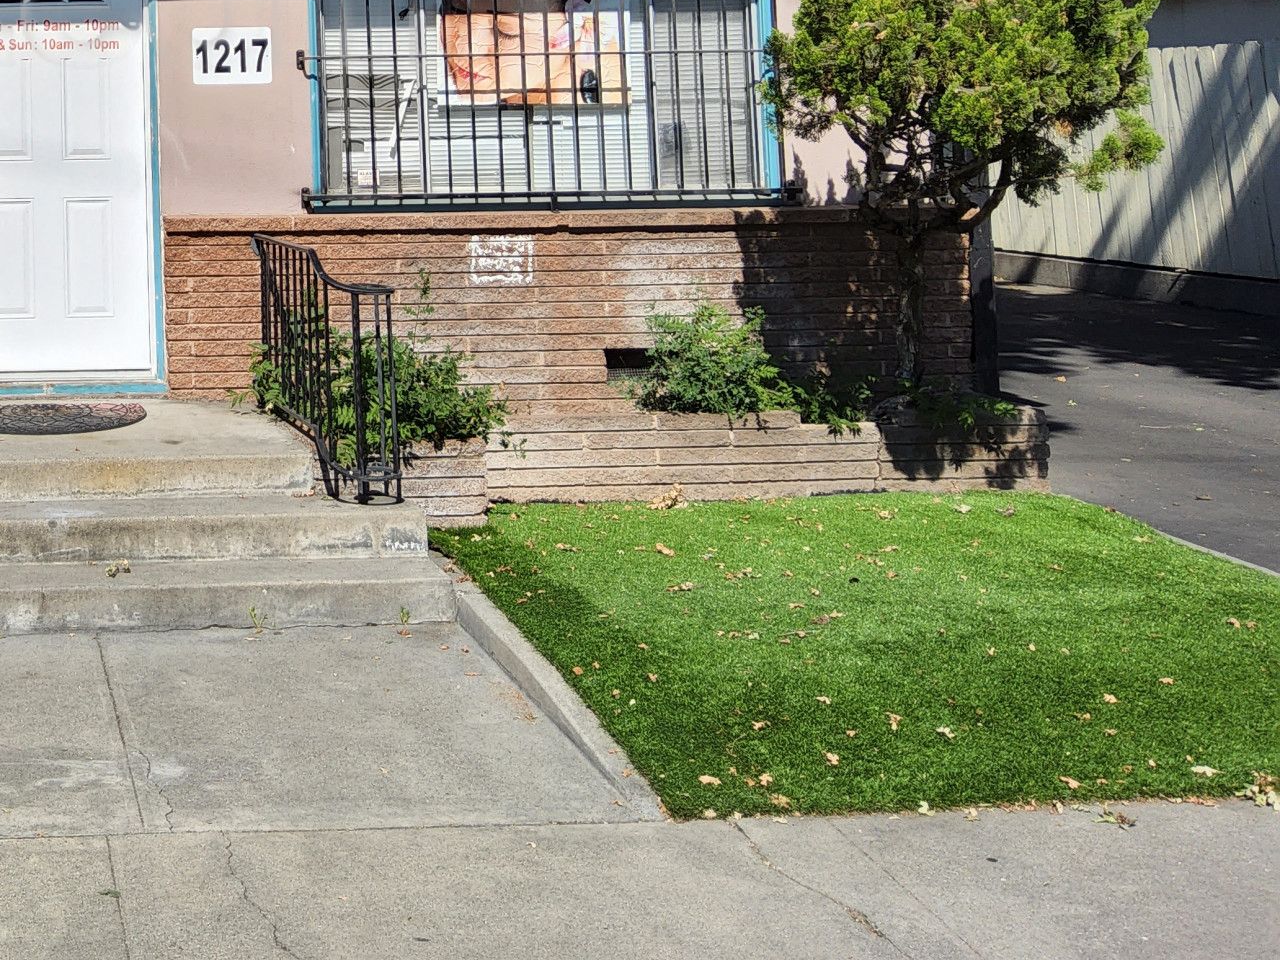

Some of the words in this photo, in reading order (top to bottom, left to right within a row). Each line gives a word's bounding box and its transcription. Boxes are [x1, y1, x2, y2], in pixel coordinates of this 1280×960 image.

[17, 19, 39, 32] Fri:
[43, 19, 71, 32] 9am
[84, 18, 119, 34] 10pm
[42, 39, 74, 51] 10am
[88, 38, 120, 52] 10pm
[195, 38, 269, 74] 1217
